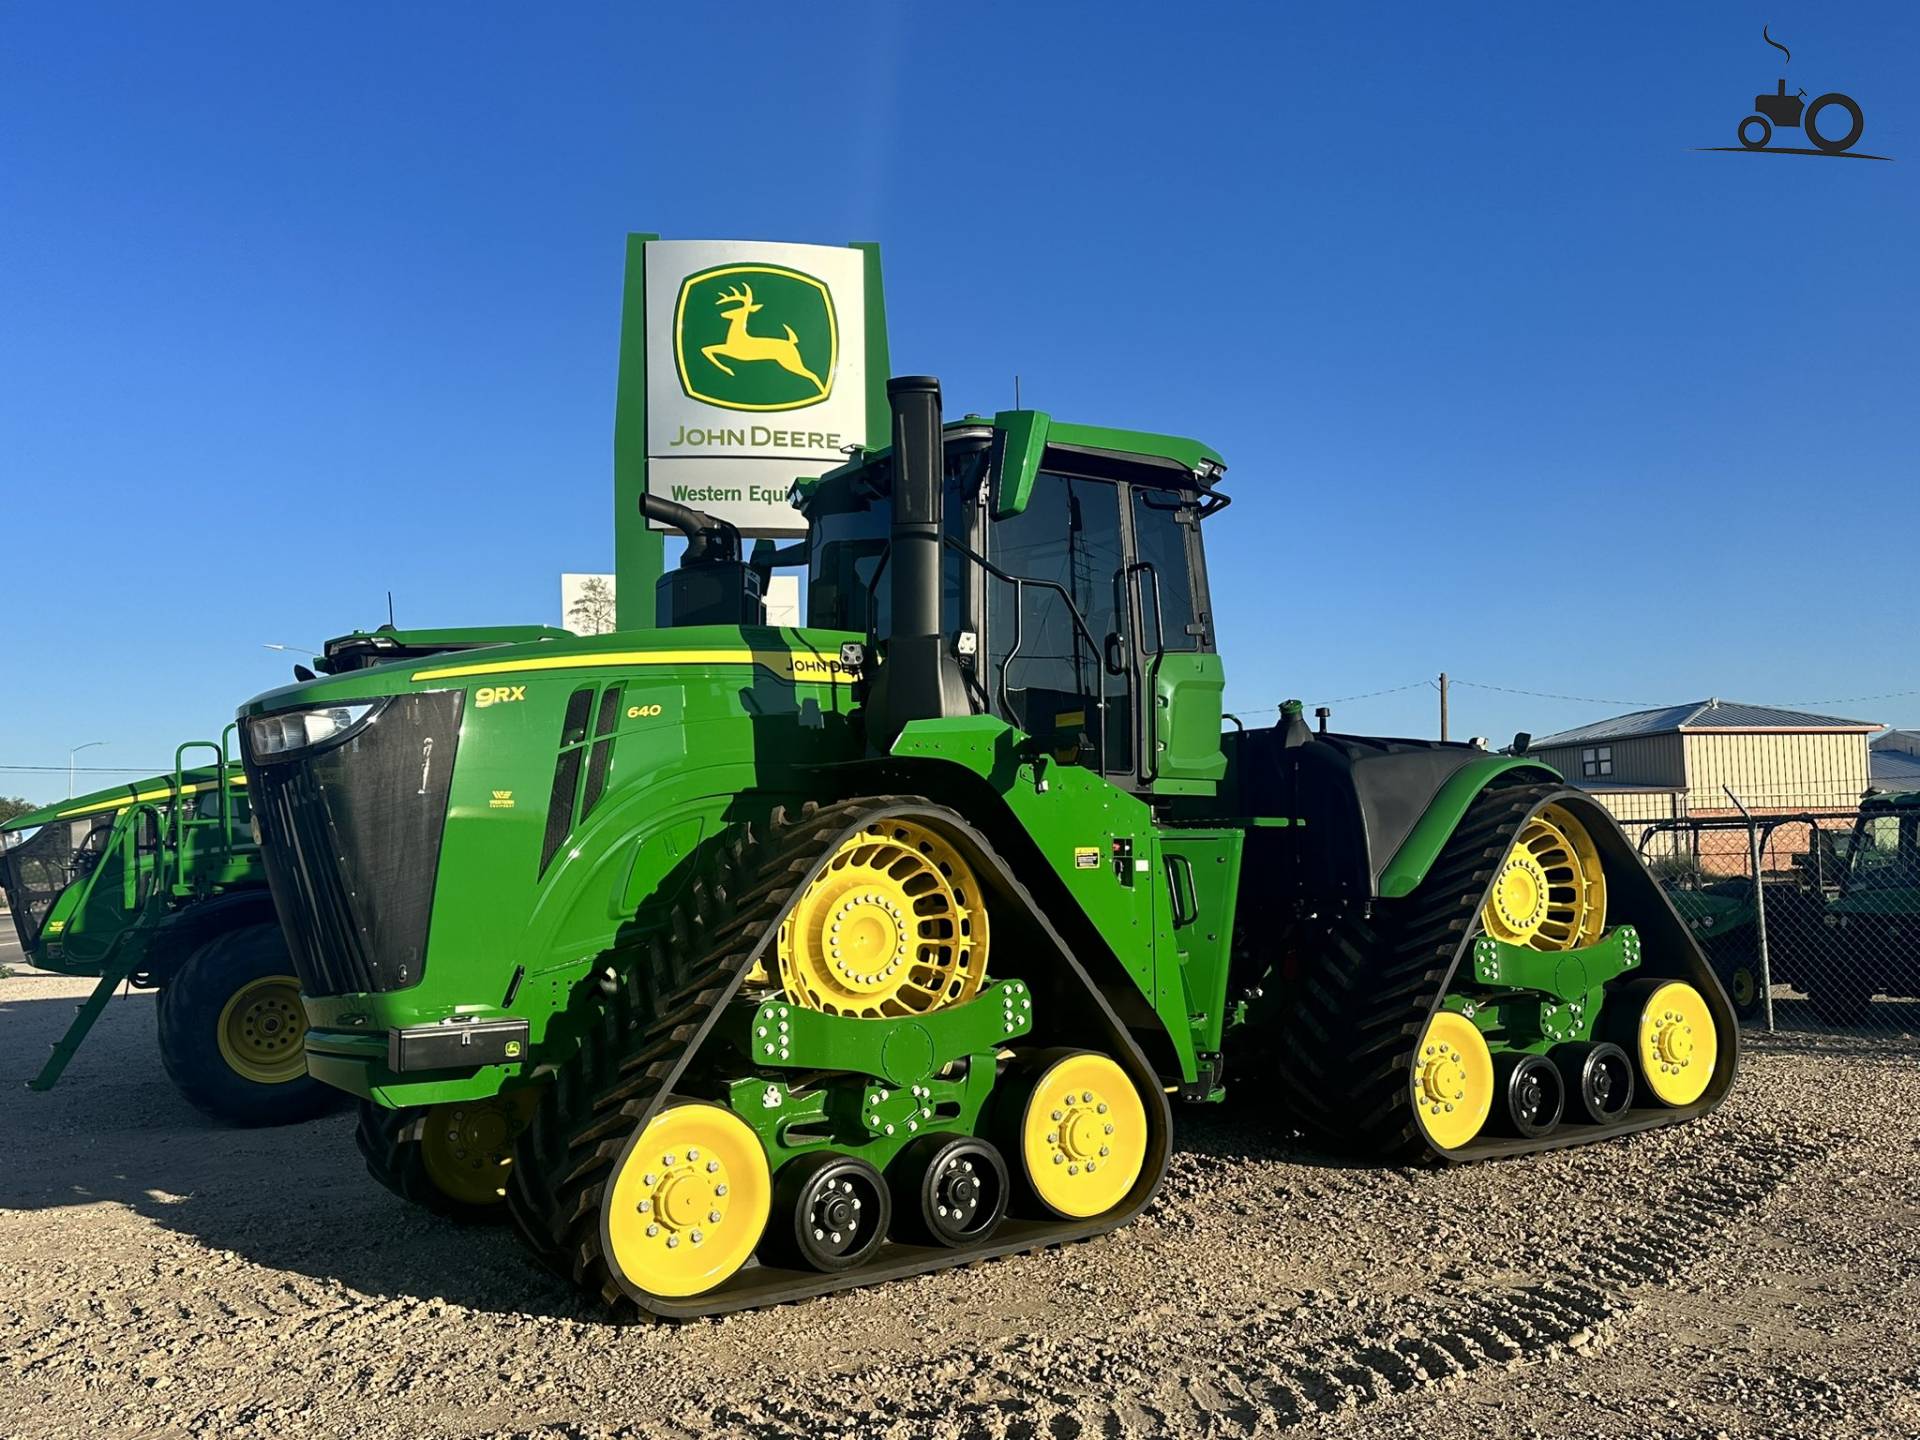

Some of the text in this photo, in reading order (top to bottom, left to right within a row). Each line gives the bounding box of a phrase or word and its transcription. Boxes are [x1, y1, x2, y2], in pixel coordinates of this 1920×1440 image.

[670, 425, 841, 449] JOHN DEERE
[671, 485, 789, 505] Western Equi
[785, 656, 828, 673] JOHN
[475, 685, 527, 708] 9RX
[626, 704, 662, 719] 640
